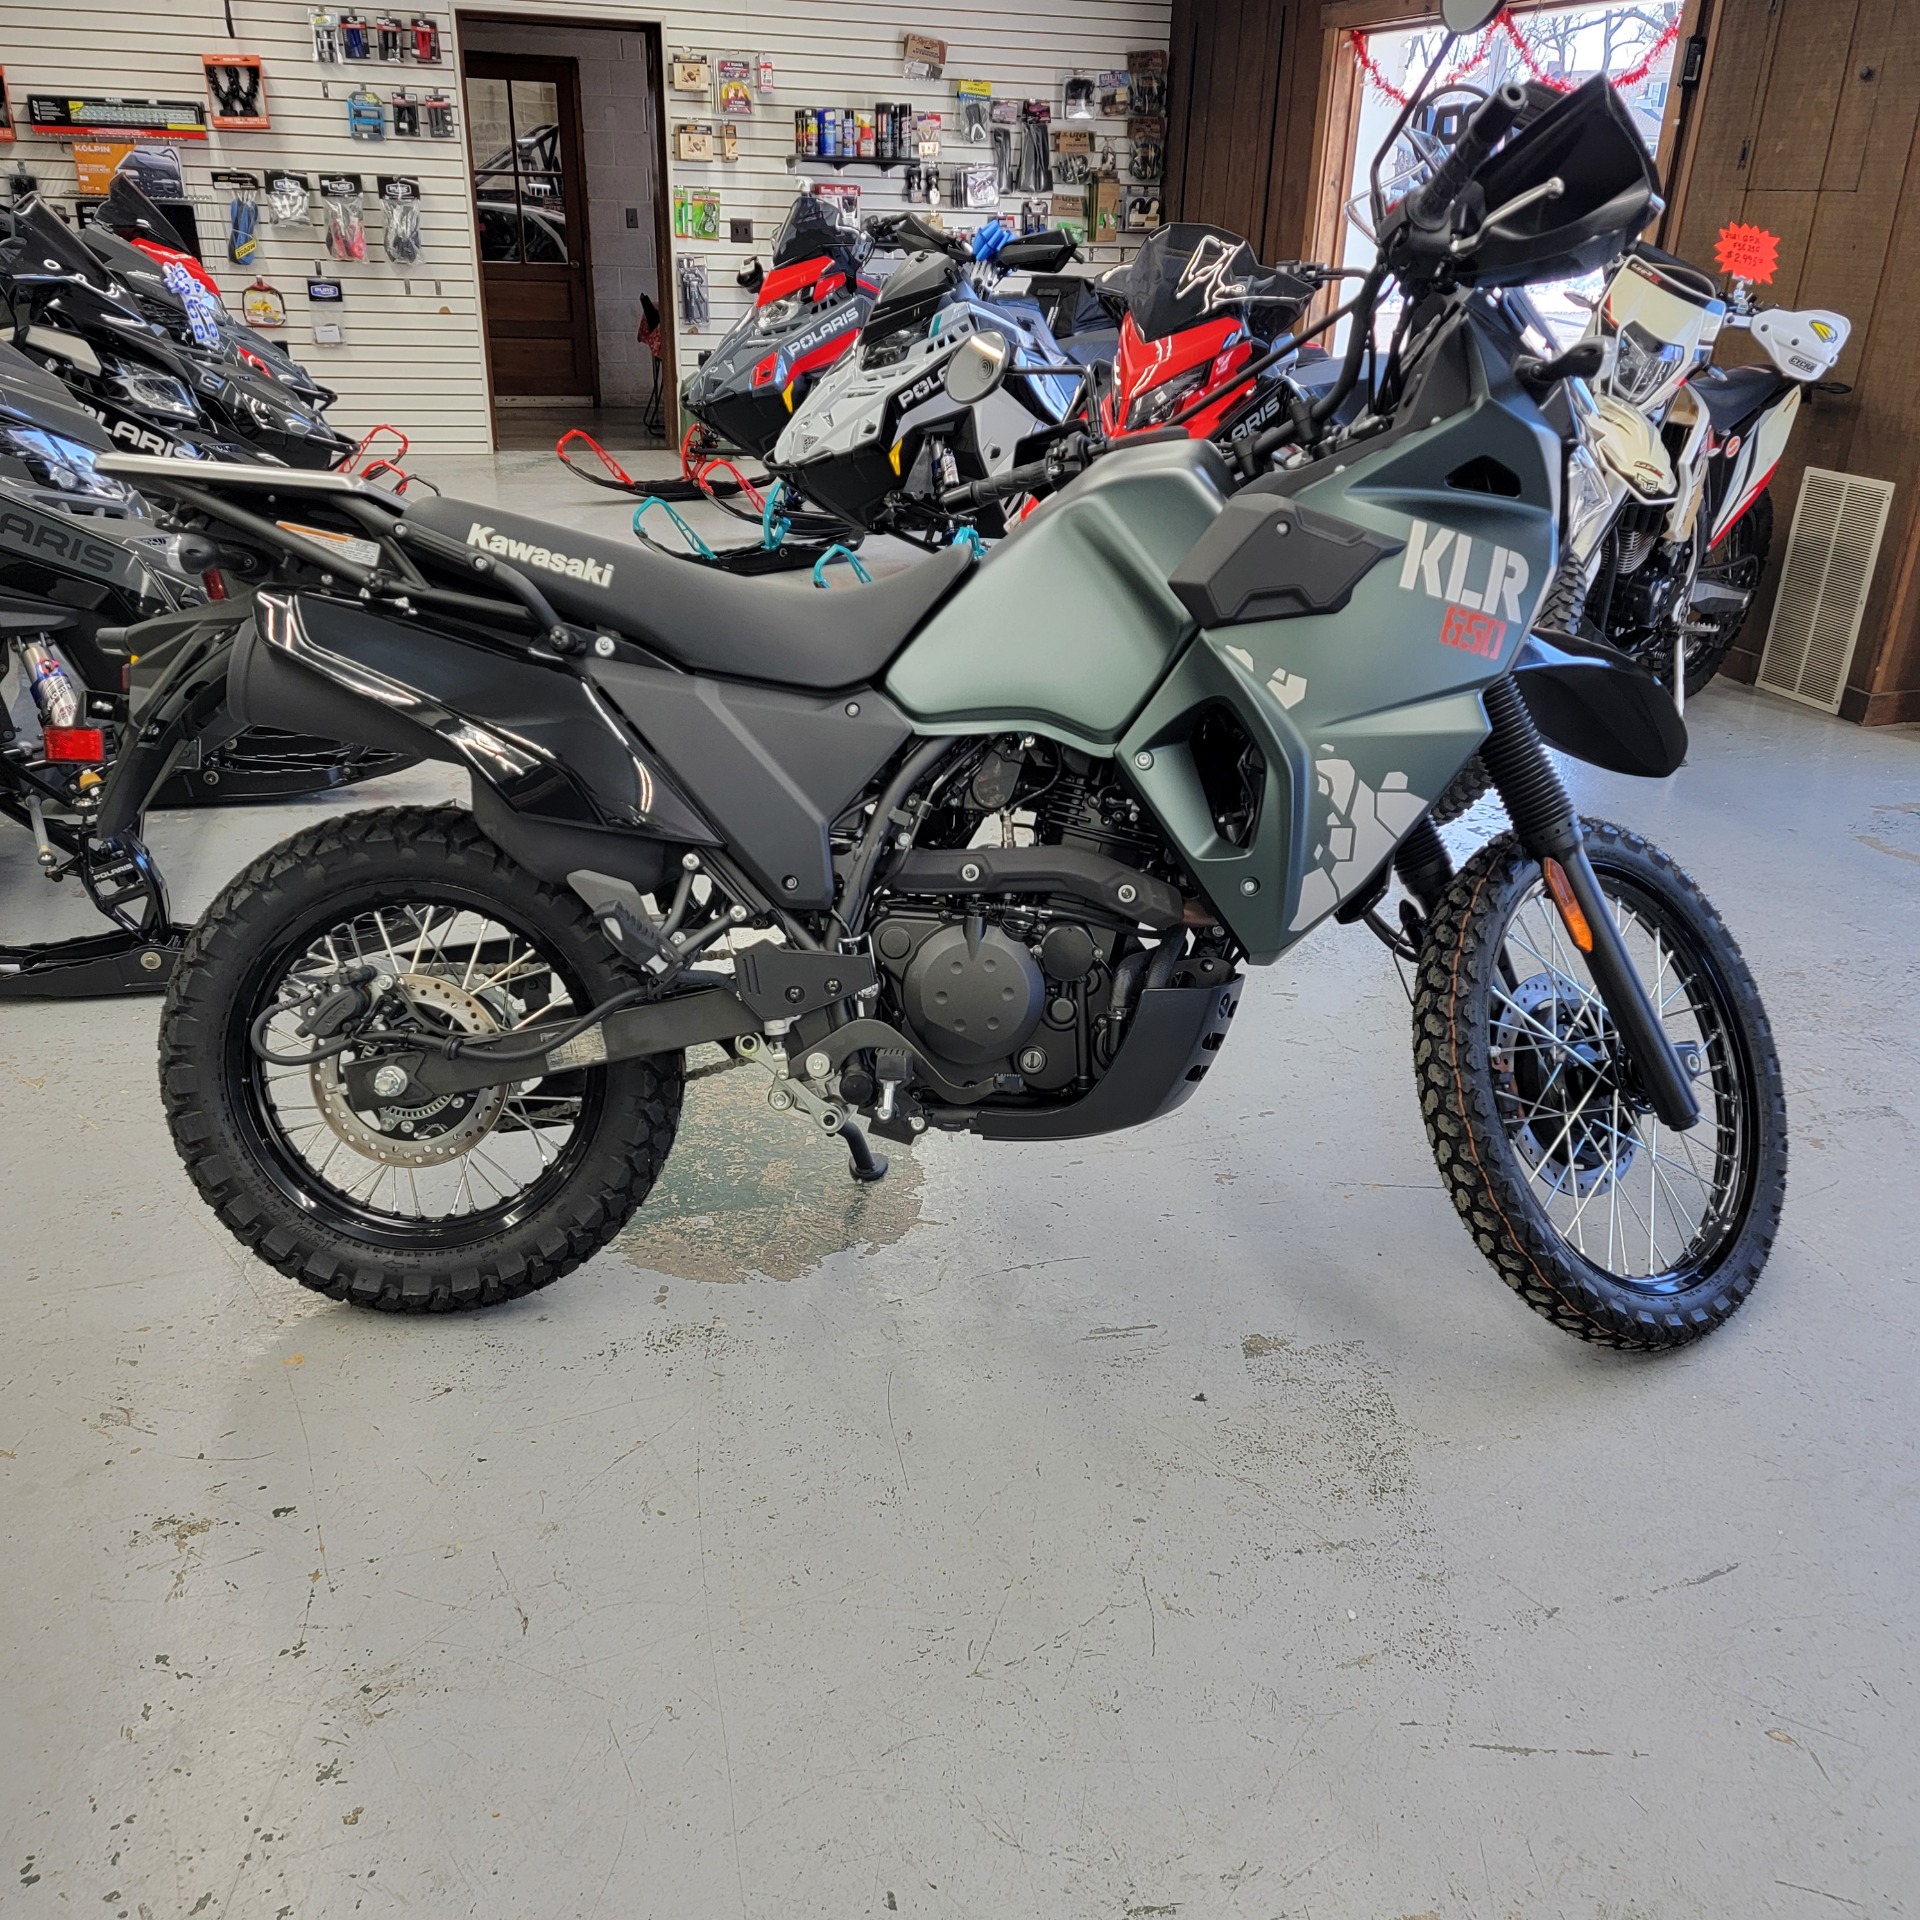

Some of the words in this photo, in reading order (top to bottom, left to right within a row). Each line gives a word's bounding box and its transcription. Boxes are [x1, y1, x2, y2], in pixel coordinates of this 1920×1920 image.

[75, 144, 111, 153] KOLPIN
[788, 307, 859, 356] POLARIS
[466, 522, 615, 588] Kawasaki
[1399, 519, 1529, 624] KLR
[1440, 604, 1507, 660] 650
[93, 863, 134, 881] POLARIS
